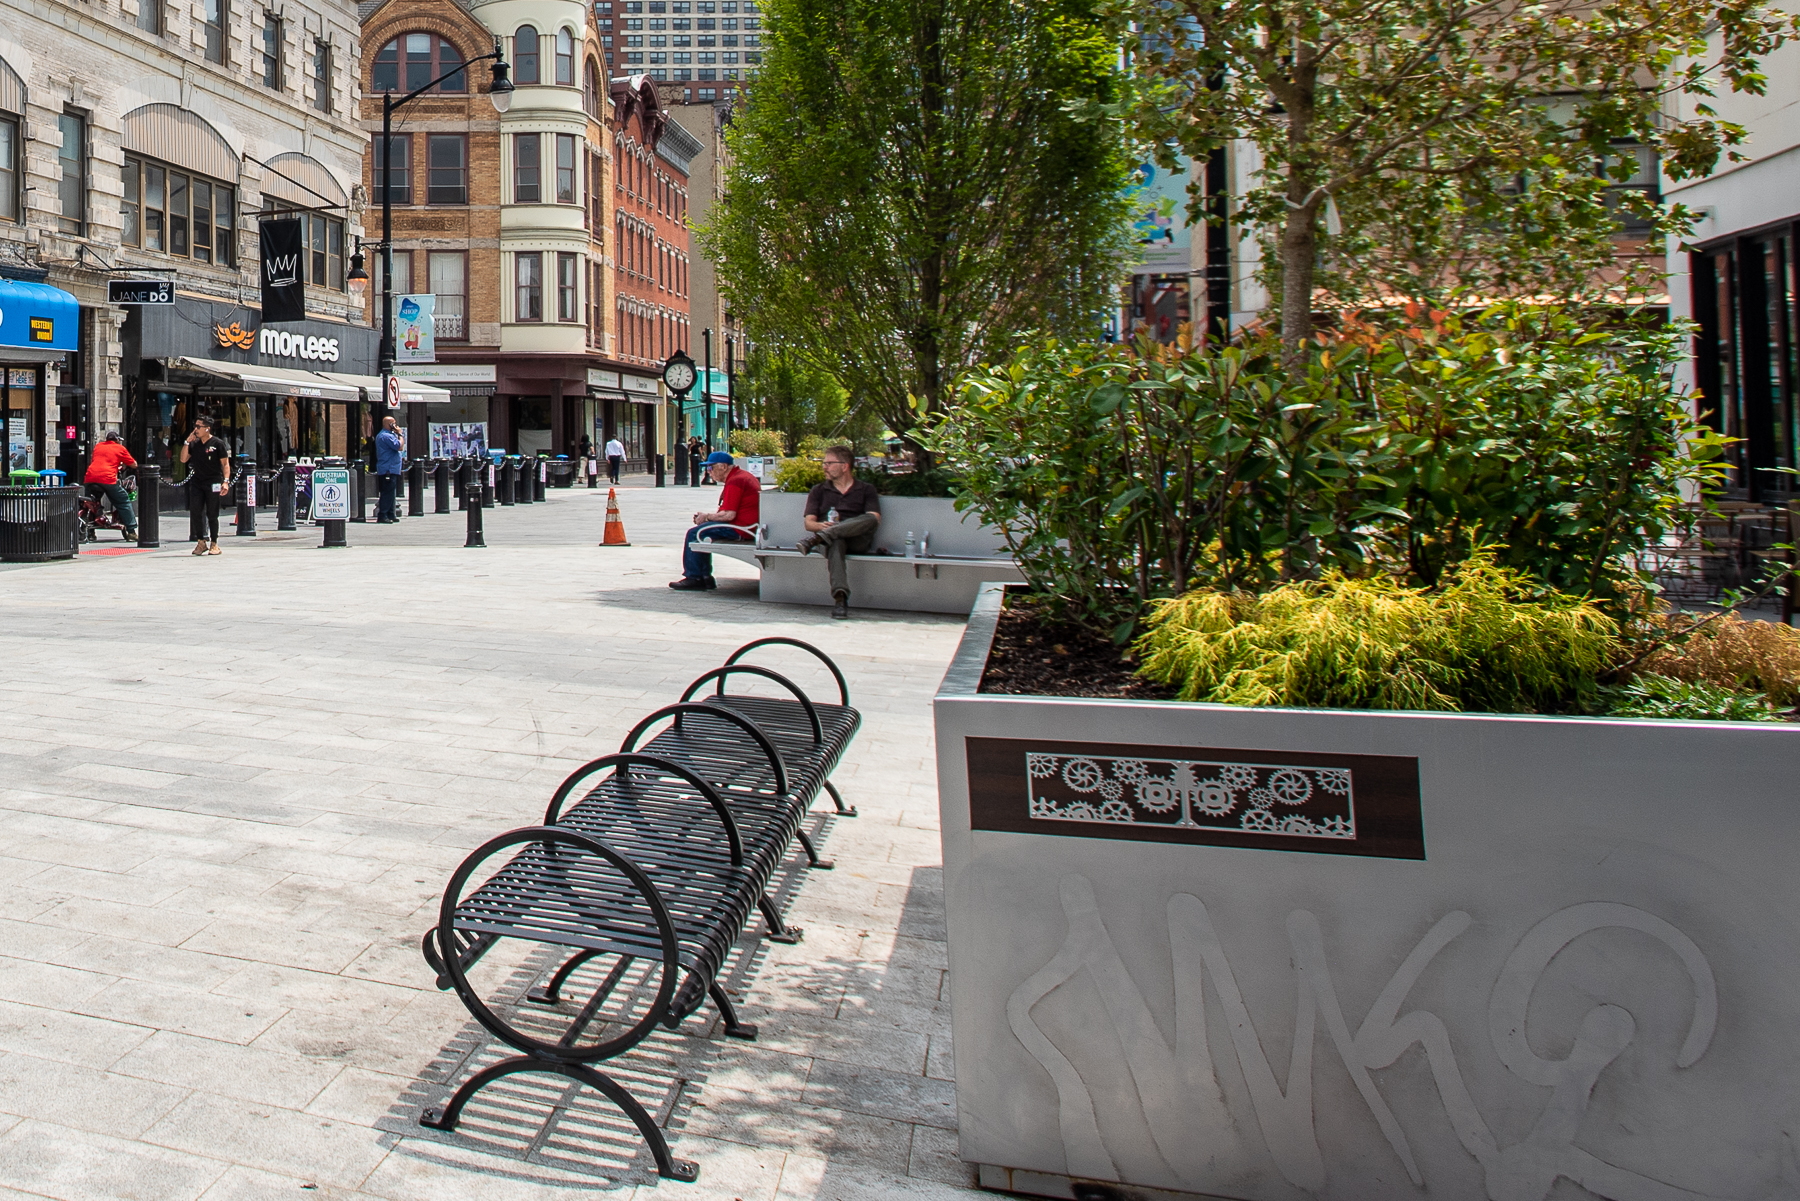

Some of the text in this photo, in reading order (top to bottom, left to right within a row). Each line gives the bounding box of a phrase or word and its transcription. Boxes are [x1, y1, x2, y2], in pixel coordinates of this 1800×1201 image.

[112, 291, 169, 303] JANE DO
[30, 319, 51, 330] WESTERN
[36, 330, 50, 340] UNION
[15, 377, 28, 385] HERE
